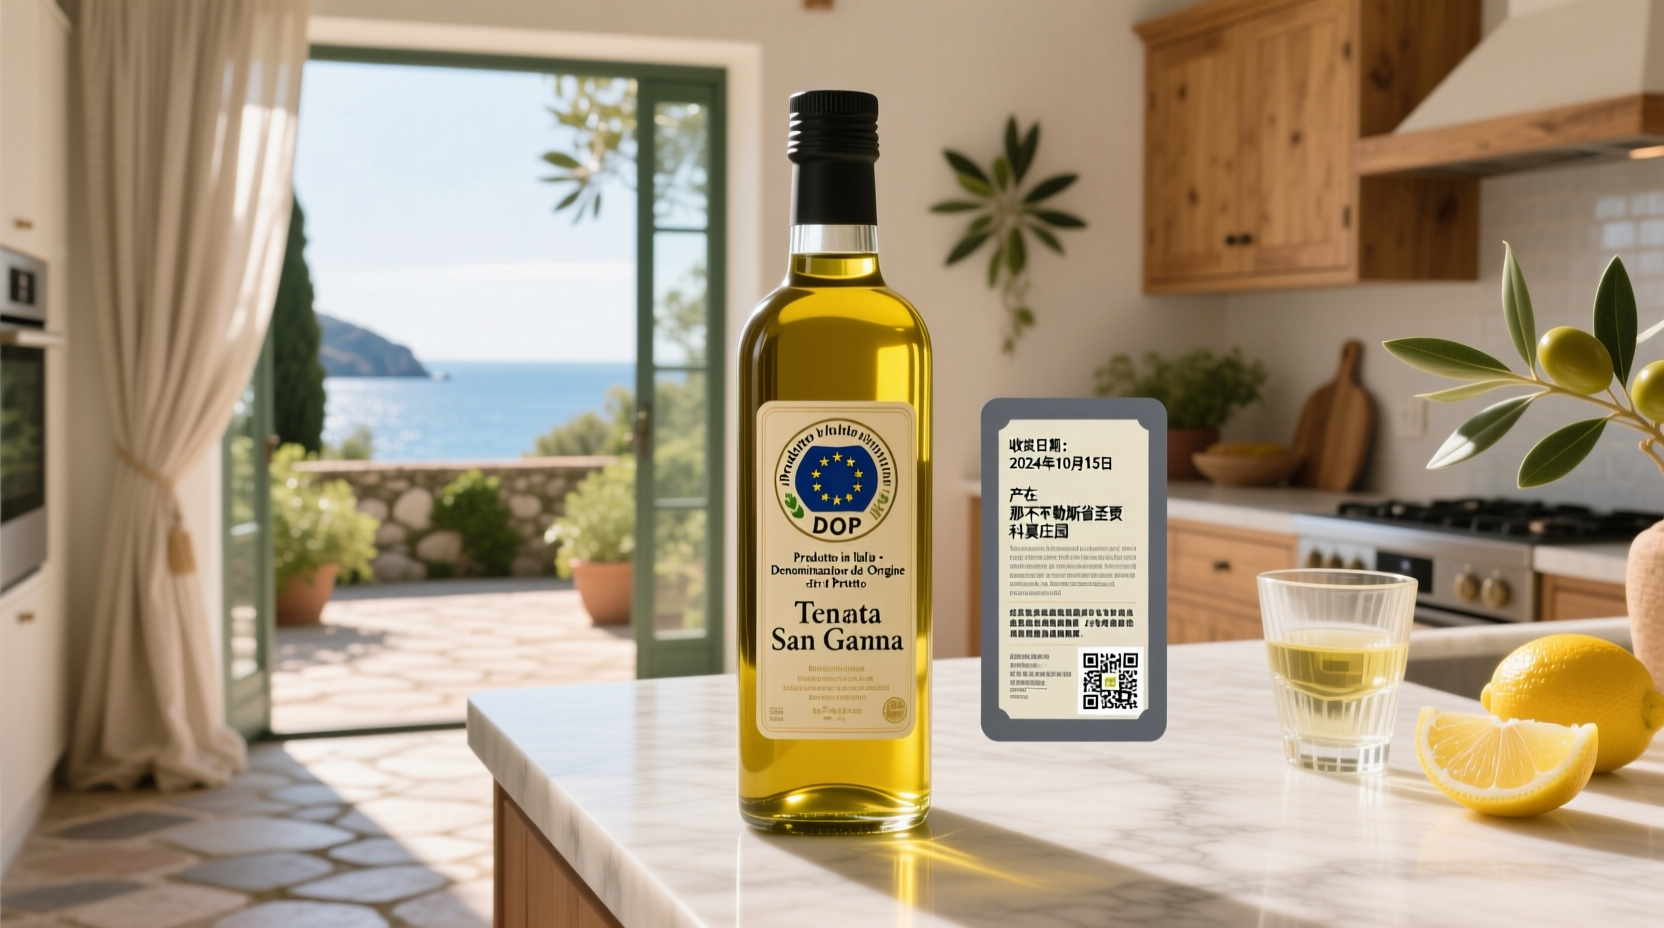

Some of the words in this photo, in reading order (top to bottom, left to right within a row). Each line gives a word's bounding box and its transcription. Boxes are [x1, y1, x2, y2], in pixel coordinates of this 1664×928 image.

[1009, 455, 1112, 471] 2024年10月15日
[1009, 486, 1038, 503] 产在
[812, 516, 862, 536] DOP
[772, 627, 816, 651] San
[823, 627, 904, 651] Ganna
